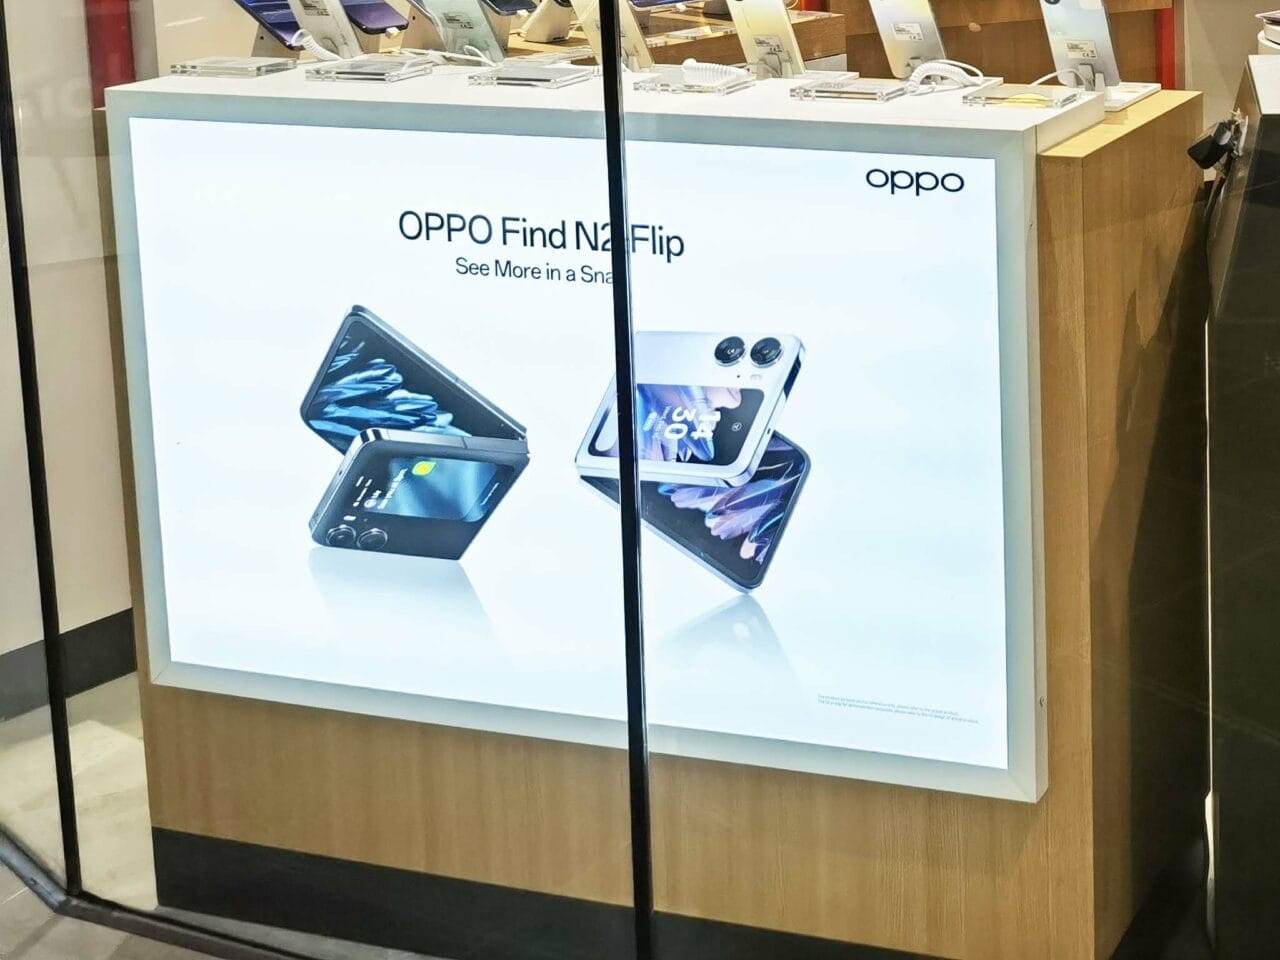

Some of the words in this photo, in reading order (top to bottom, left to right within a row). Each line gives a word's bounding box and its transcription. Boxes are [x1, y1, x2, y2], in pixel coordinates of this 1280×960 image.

[865, 167, 965, 197] oppo
[399, 209, 493, 245] OPPO
[502, 217, 567, 250] Find
[631, 224, 685, 263] Flip
[455, 257, 490, 277] See
[494, 260, 541, 280] More
[545, 263, 561, 281] in
[566, 269, 576, 282] a
[581, 265, 613, 284] Sna
